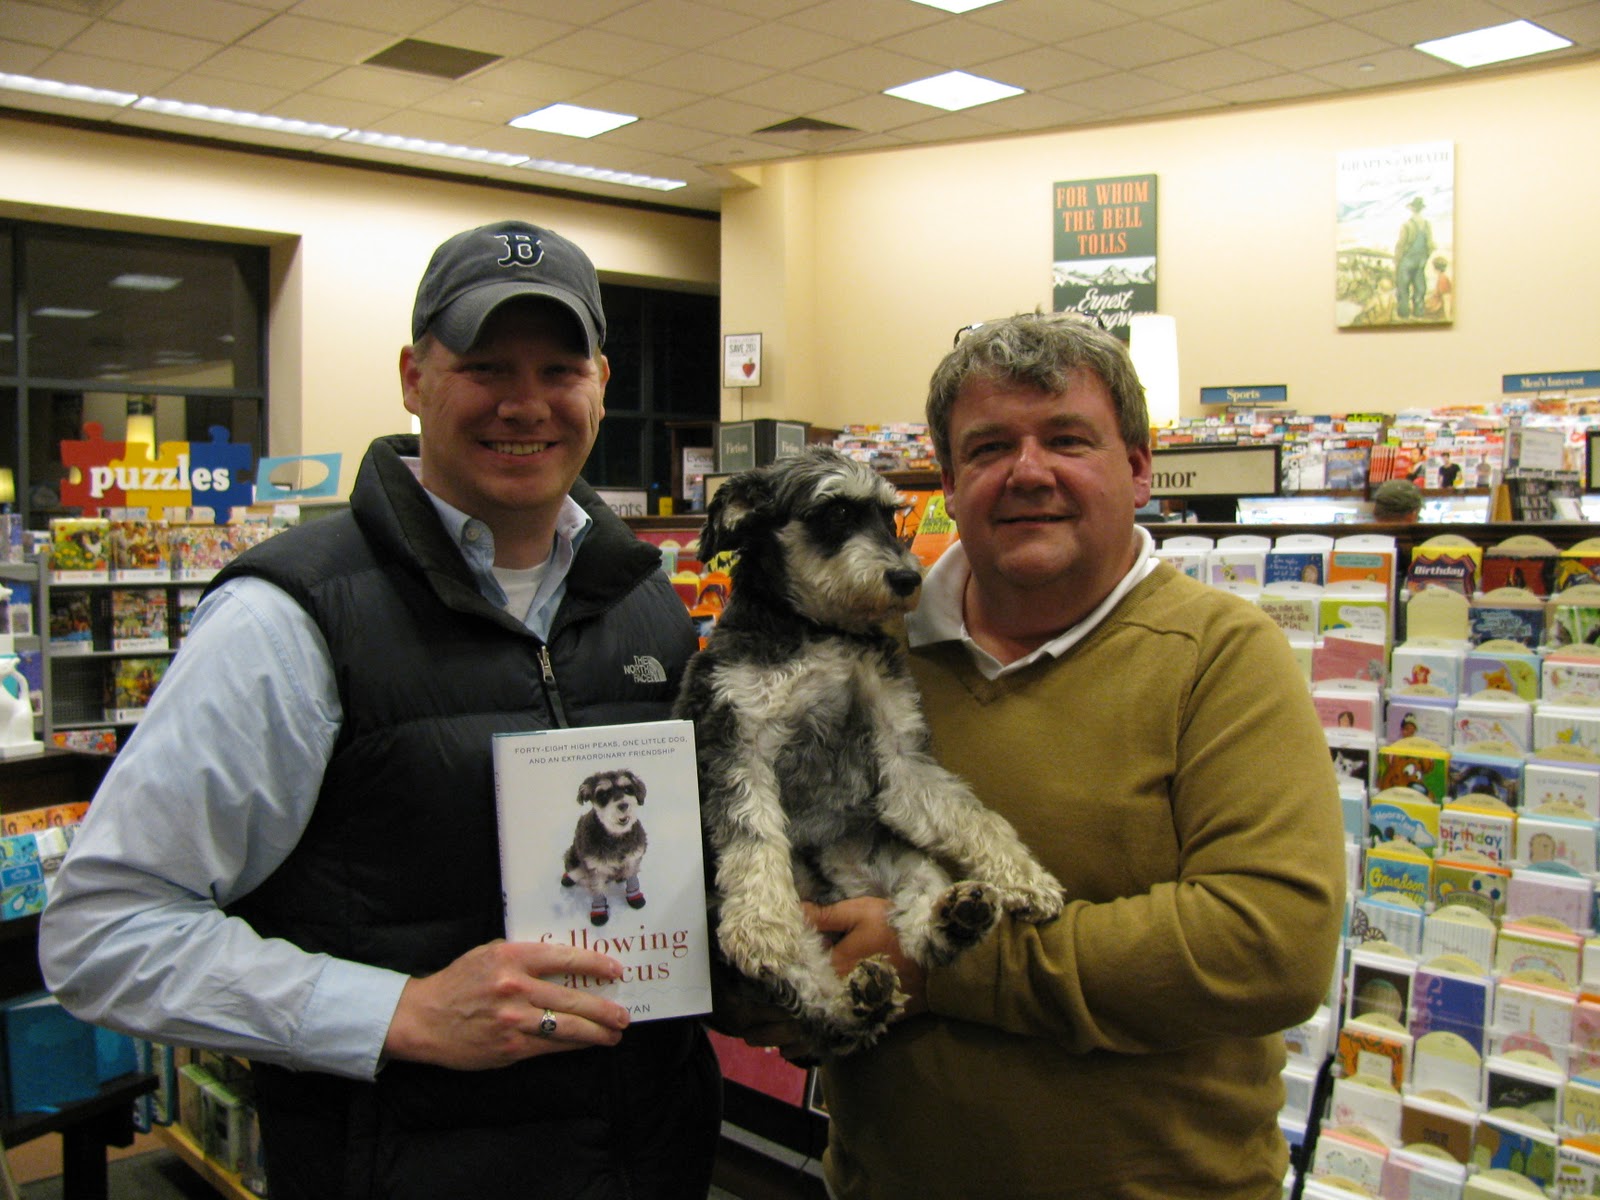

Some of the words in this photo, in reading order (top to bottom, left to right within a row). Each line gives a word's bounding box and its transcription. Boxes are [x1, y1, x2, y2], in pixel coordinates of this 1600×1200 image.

[1056, 186, 1088, 209] FOR
[1096, 181, 1149, 206] WHOM
[1062, 209, 1096, 232] THE
[1102, 206, 1143, 230] BELL
[493, 232, 545, 267] B
[1077, 232, 1127, 256] TOLLS
[1077, 288, 1134, 312] Ernest
[1520, 377, 1547, 389] Men's
[1547, 376, 1584, 387] Interest
[1226, 388, 1260, 402] Sports
[90, 453, 231, 499] puzzles
[1414, 565, 1466, 578] Birthday
[624, 665, 650, 674] NORTH
[633, 655, 649, 665] THE
[634, 674, 652, 683] FACE
[514, 744, 568, 754] FORTY-EIGHT
[570, 742, 590, 750] HIGH
[592, 740, 620, 748] PEAKS,
[641, 737, 666, 745] LITTLE
[561, 752, 626, 762] EXTRAORDINARY
[628, 748, 676, 757] FRIENDSHIP
[1439, 826, 1502, 848] birthday
[541, 925, 689, 959] llowing
[563, 962, 670, 990] atcus
